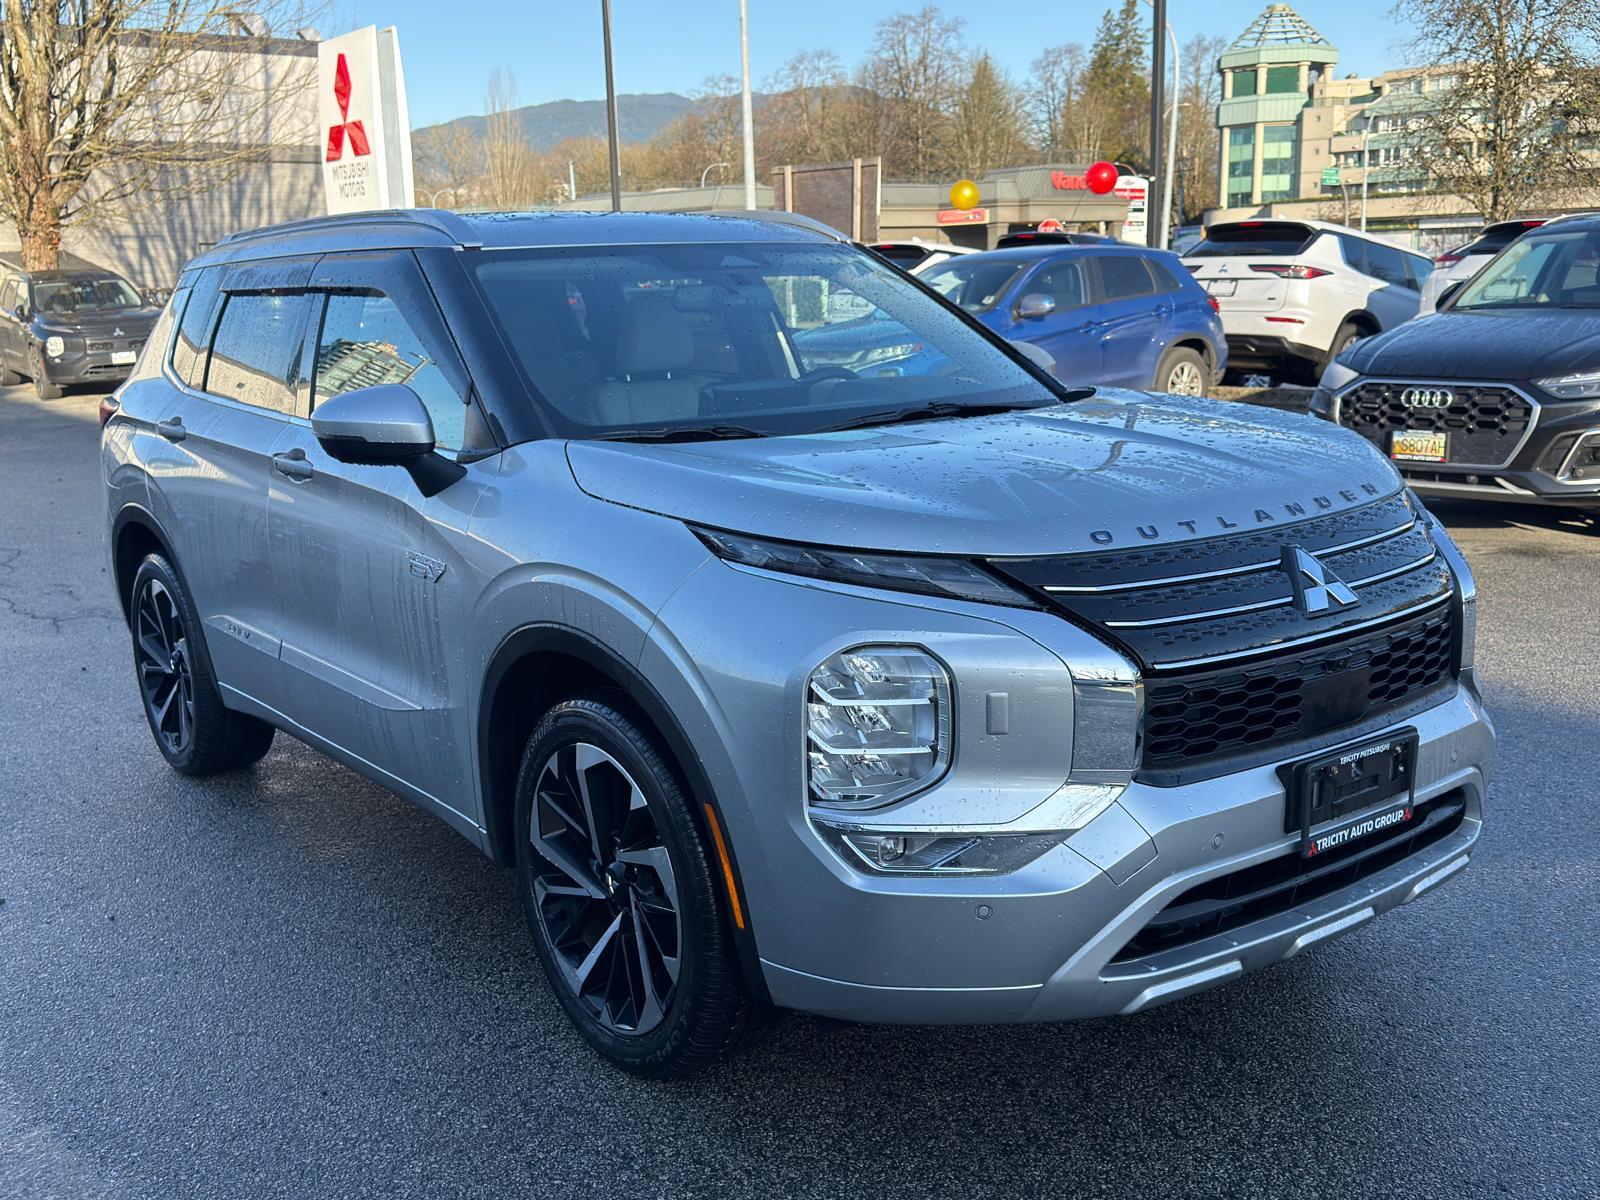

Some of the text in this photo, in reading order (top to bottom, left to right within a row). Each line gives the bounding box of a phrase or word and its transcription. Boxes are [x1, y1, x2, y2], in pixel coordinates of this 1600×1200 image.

[332, 161, 370, 181] MITSUBISHI
[339, 180, 366, 198] MOTORS
[1090, 482, 1380, 545] OUTLANDER
[1340, 742, 1390, 765] TRICITY MITSUBISHI
[1316, 809, 1404, 851] TRICITY AUTO GROUP
